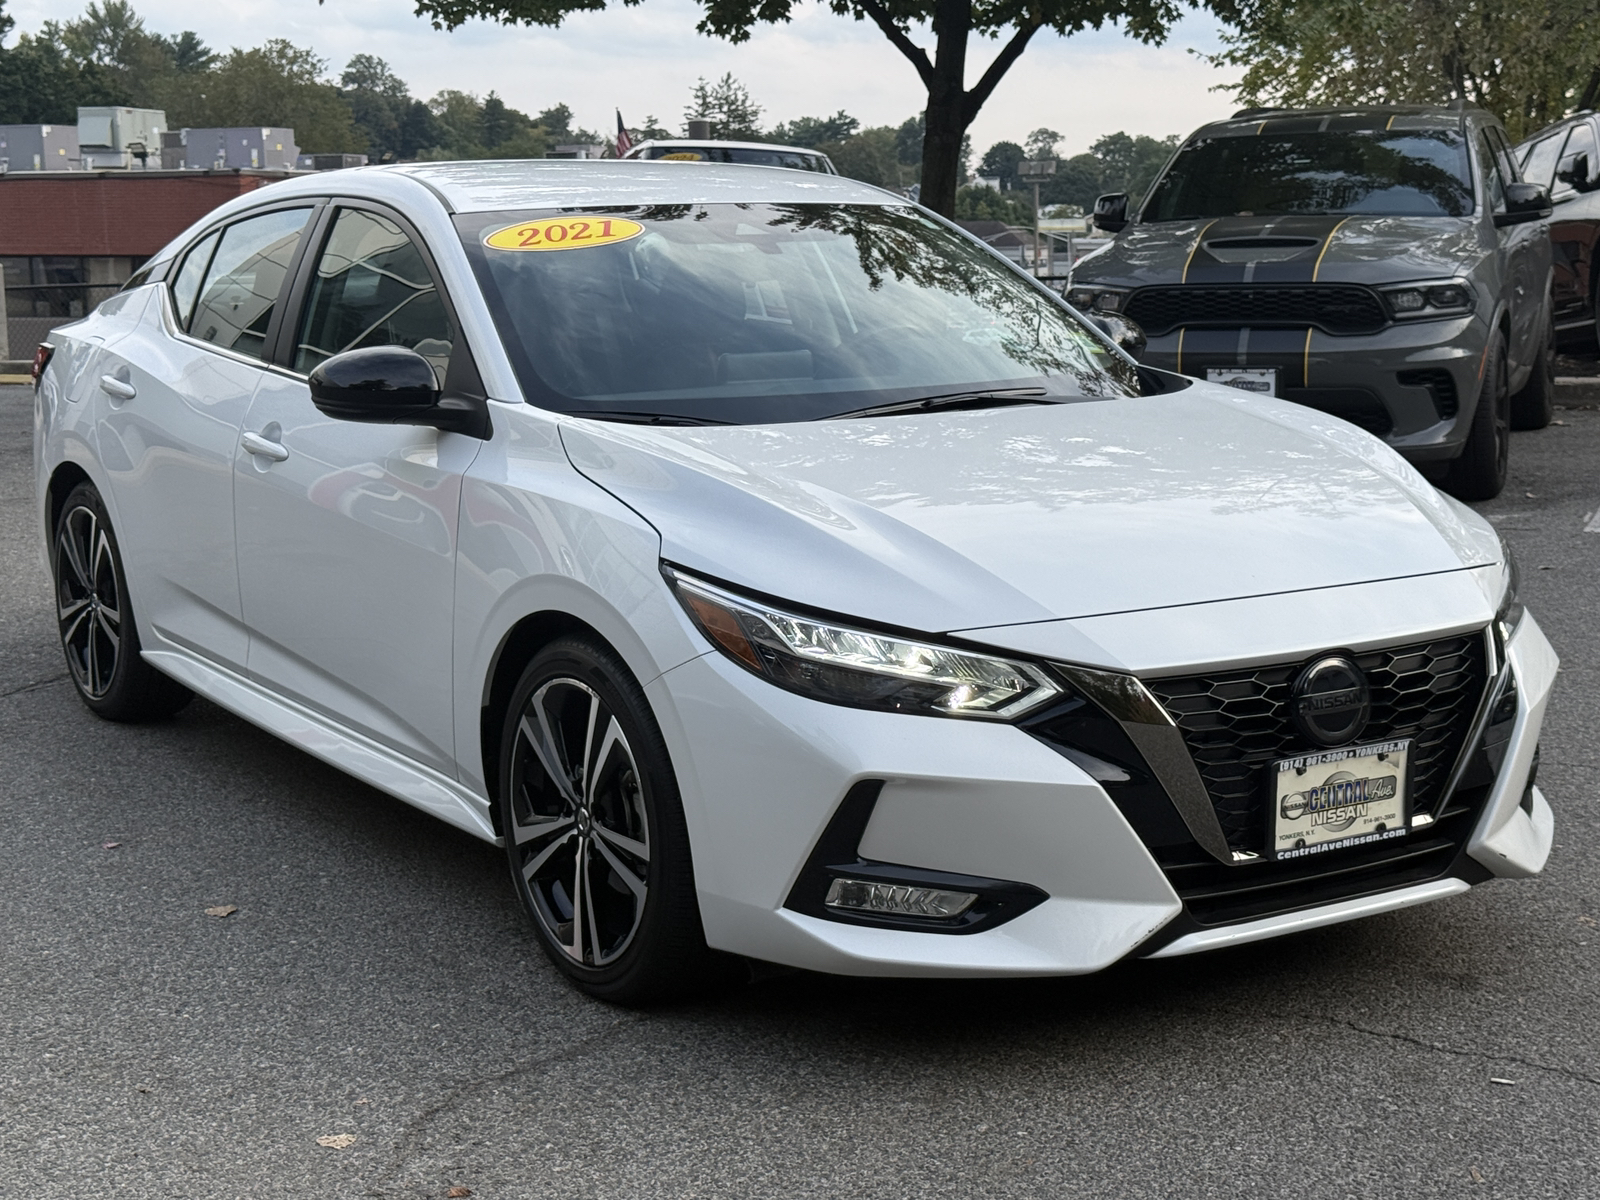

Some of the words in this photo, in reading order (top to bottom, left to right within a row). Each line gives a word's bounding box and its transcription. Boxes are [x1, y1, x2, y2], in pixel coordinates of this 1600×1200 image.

[517, 220, 616, 247] 2021
[1308, 690, 1362, 711] NISSAN
[1308, 777, 1369, 812] CENTRAL
[1311, 803, 1368, 828] NISSAN
[1277, 828, 1406, 860] CentralAveNissan.com
